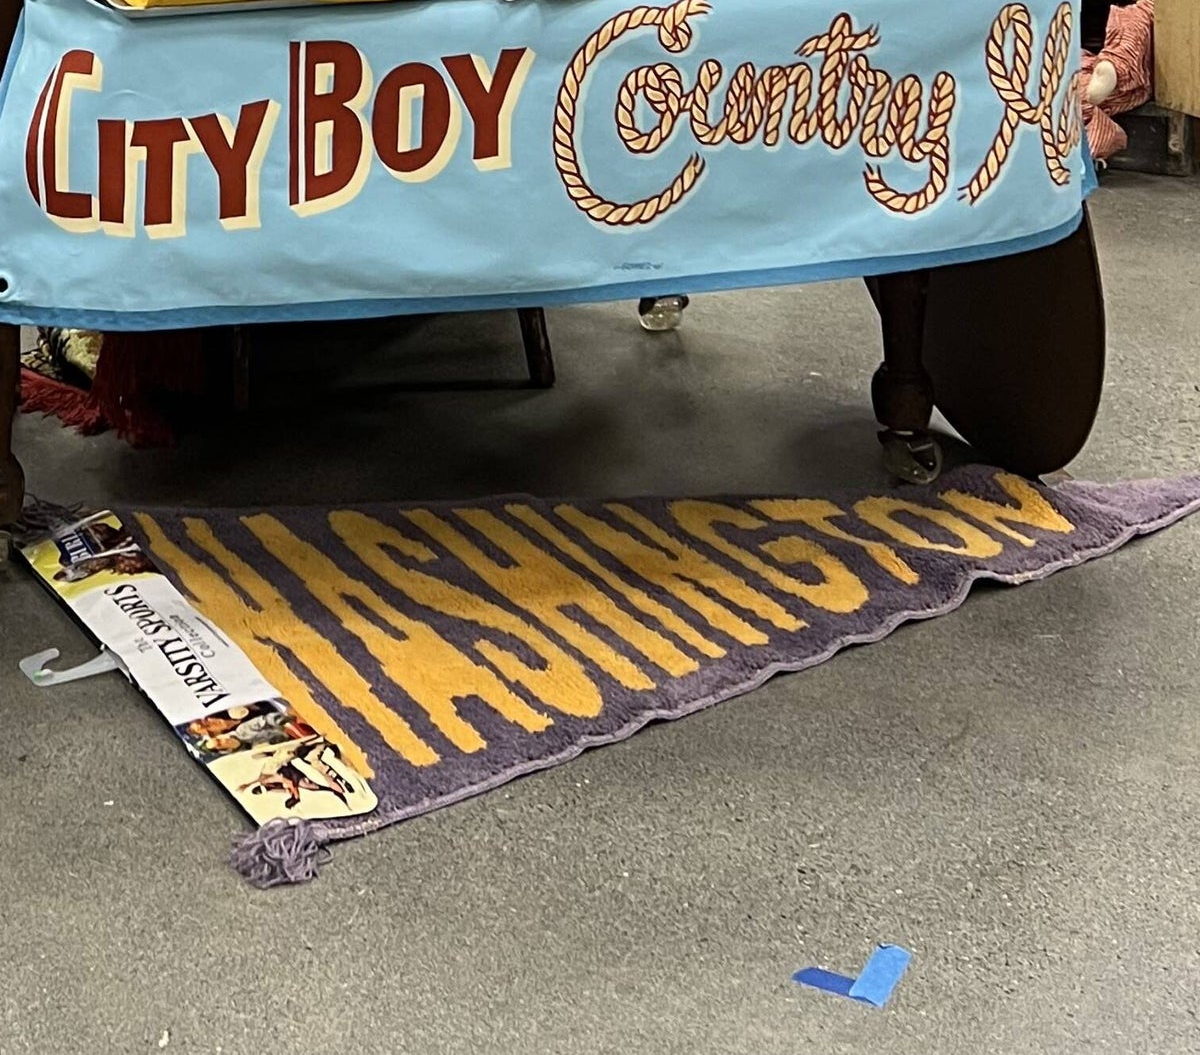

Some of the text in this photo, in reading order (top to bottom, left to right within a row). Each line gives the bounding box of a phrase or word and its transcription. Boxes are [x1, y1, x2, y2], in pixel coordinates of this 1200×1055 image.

[25, 48, 280, 240] CITY
[289, 40, 535, 217] BOY
[104, 584, 231, 708] VARSITY SPORTS
[132, 472, 1076, 779] WASHINGTON
